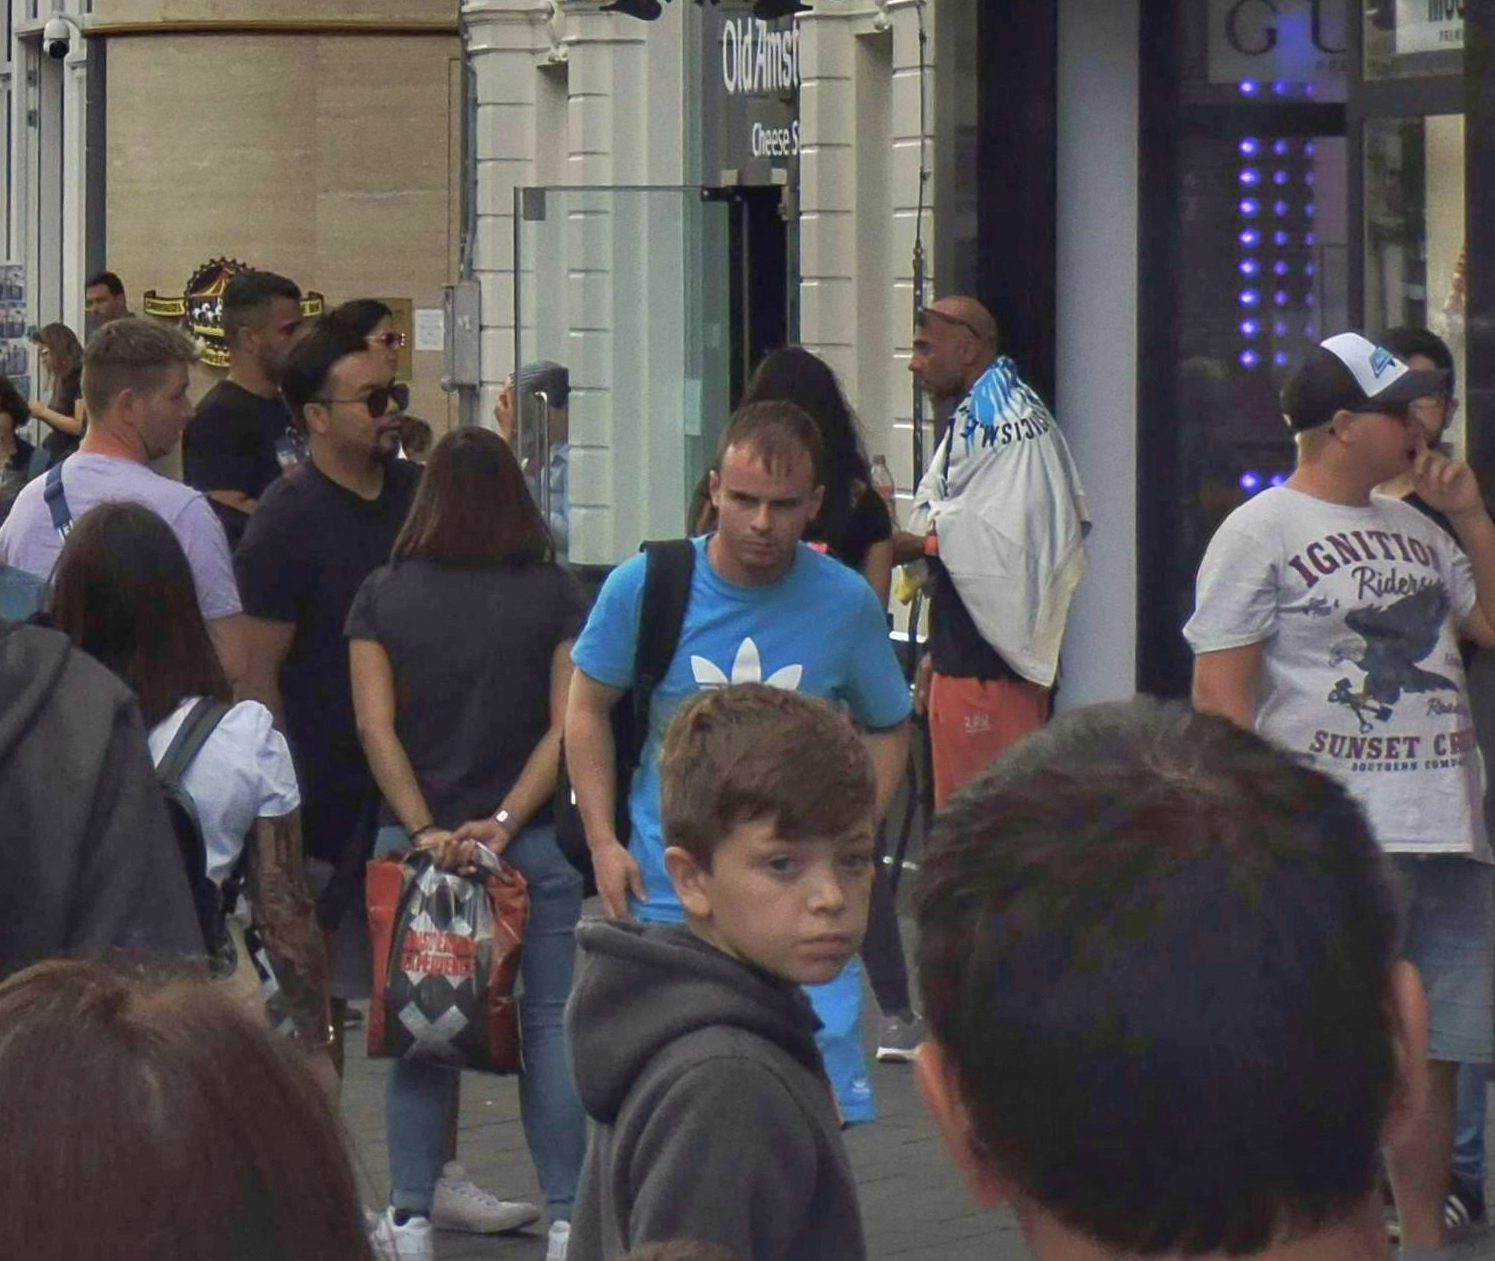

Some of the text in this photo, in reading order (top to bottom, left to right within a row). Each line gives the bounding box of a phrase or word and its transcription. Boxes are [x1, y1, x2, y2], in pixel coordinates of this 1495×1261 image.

[722, 17, 801, 94] Old Amst
[752, 122, 790, 157] Cheese
[1309, 730, 1421, 760] SUNSET
